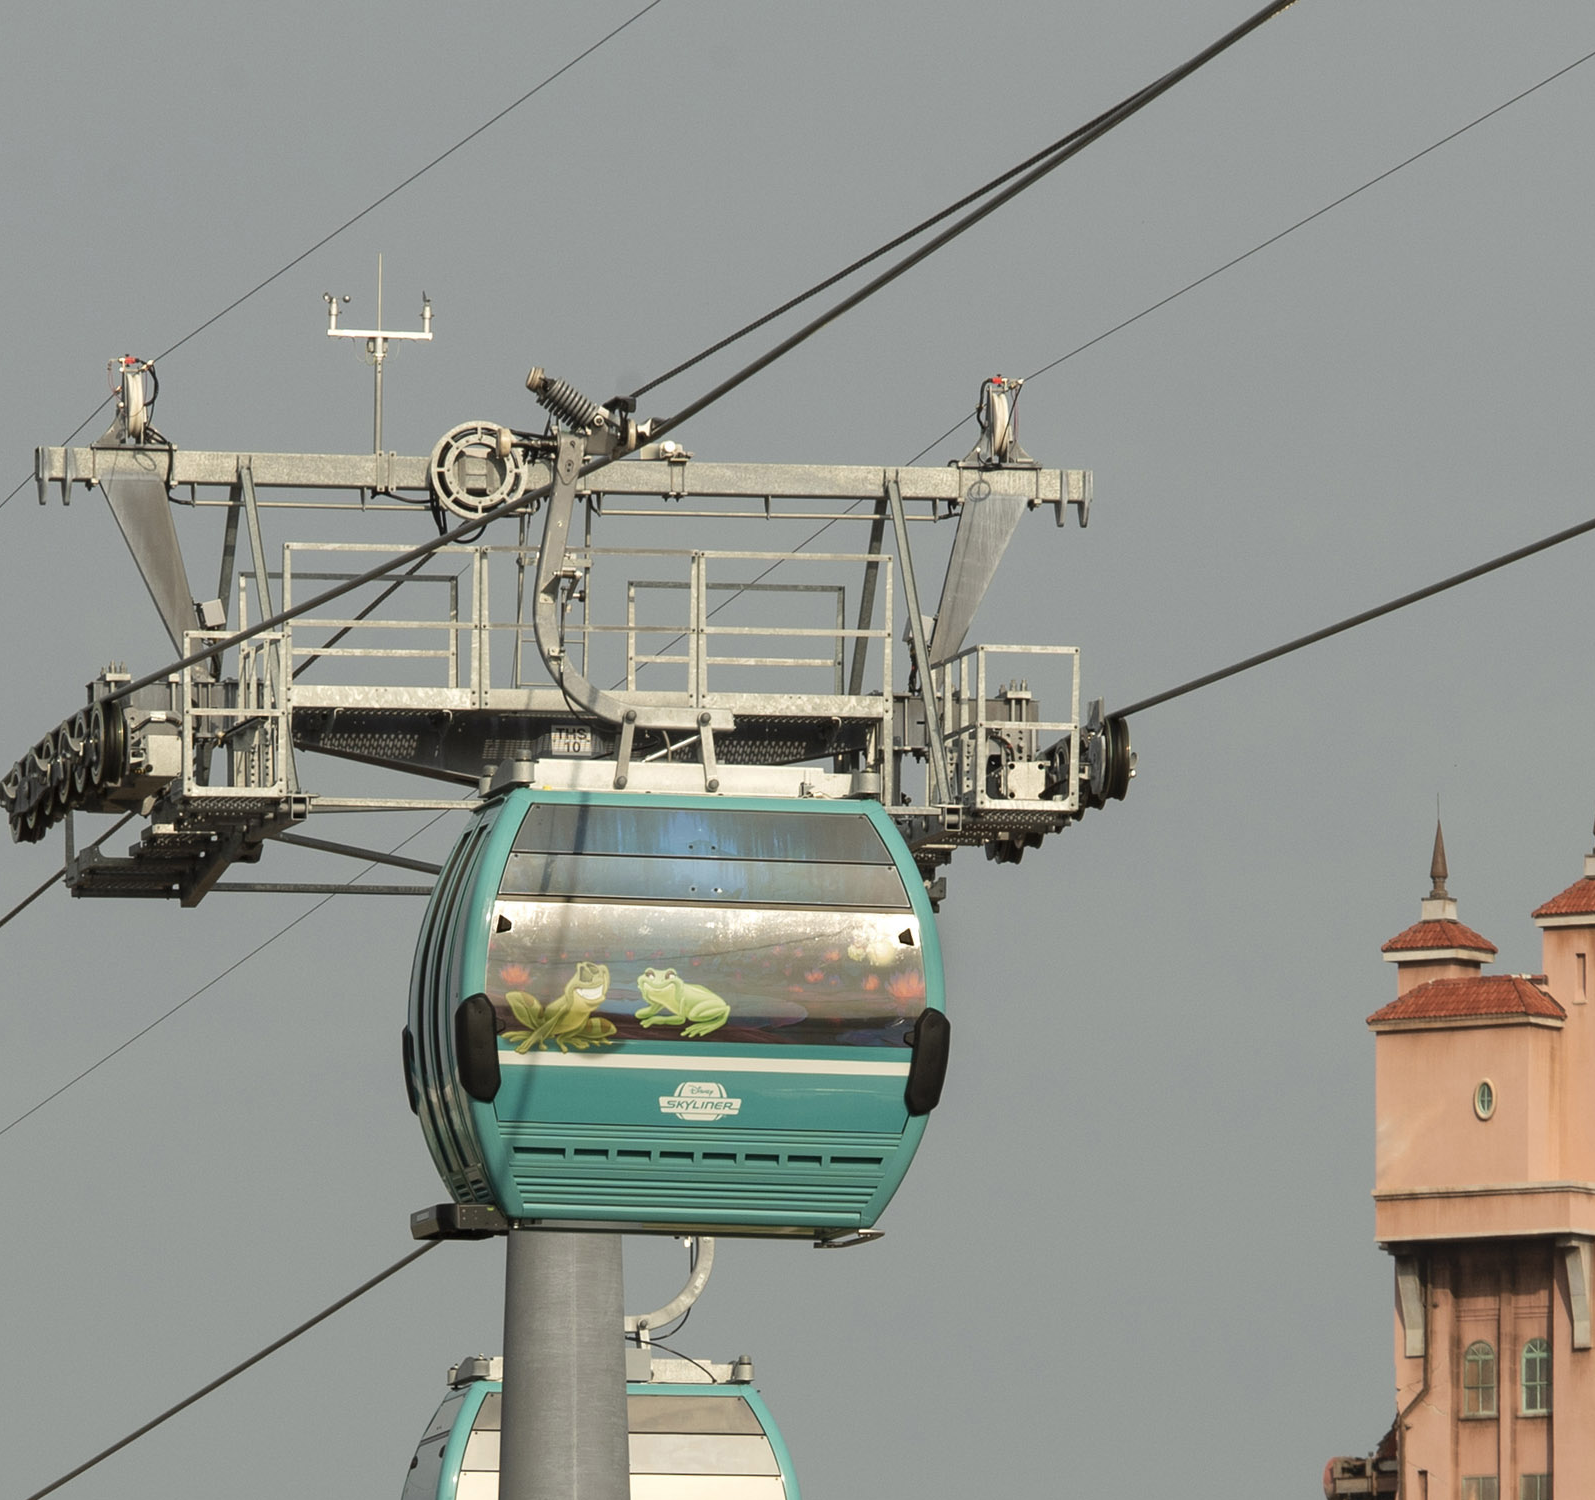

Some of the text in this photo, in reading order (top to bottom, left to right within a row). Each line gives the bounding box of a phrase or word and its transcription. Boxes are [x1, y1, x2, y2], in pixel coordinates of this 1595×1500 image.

[556, 728, 587, 740] THS
[565, 741, 581, 753] 10
[688, 1085, 714, 1097] Disney
[666, 1100, 735, 1111] SKYLINER
